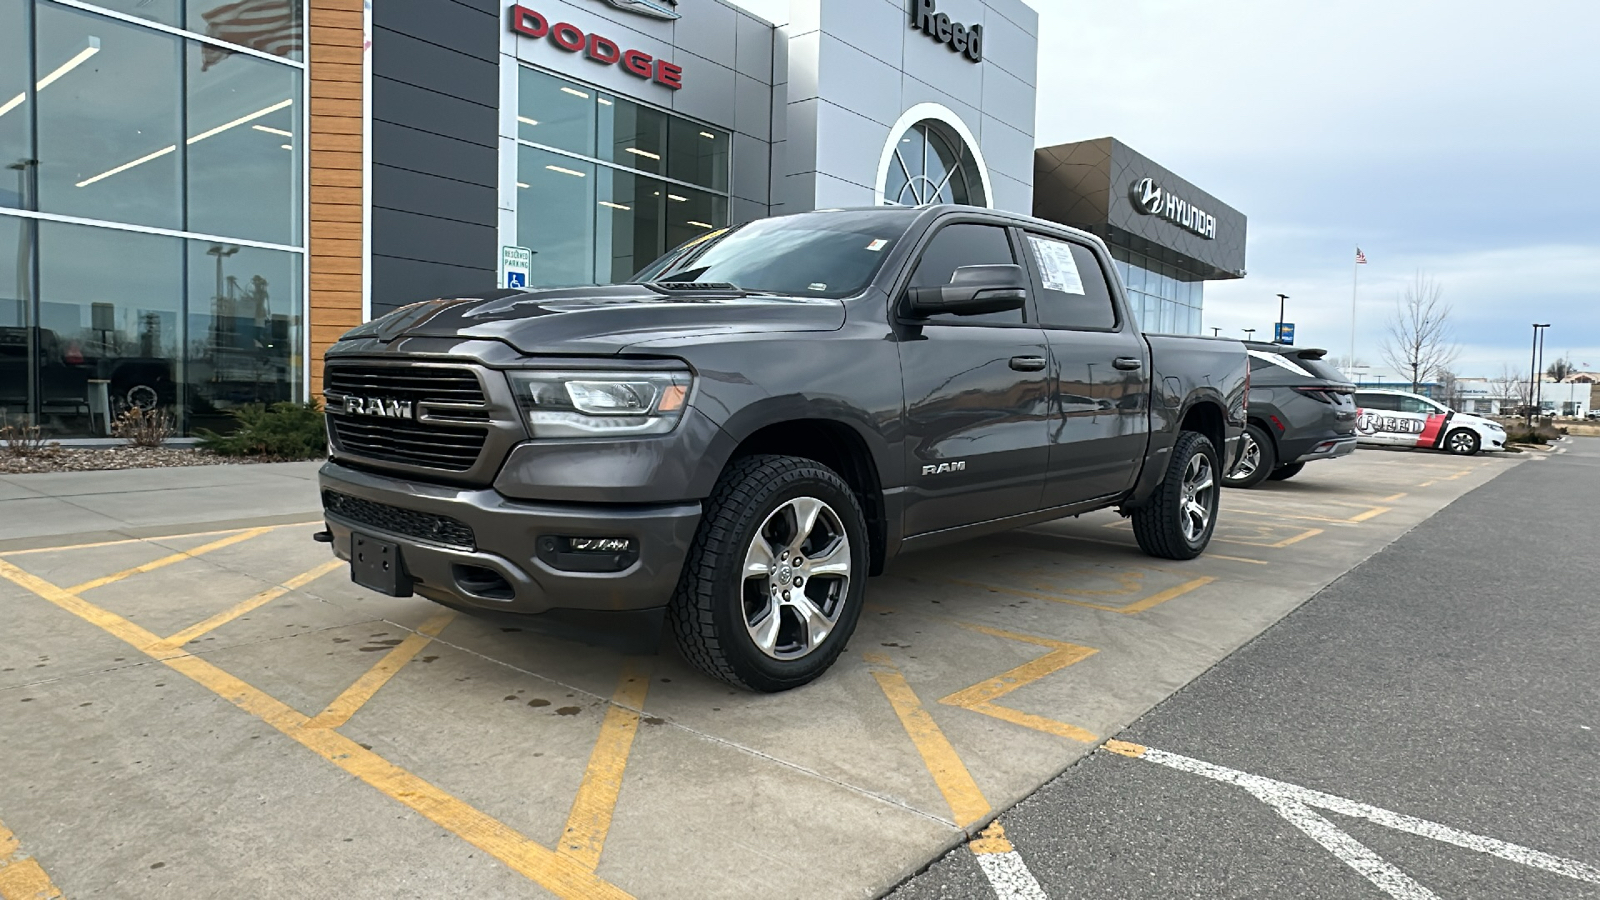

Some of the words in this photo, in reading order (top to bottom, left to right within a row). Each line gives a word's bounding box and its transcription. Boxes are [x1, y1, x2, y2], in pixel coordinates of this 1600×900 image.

[911, 0, 984, 63] Reed
[510, 3, 683, 90] DODGE
[1165, 192, 1216, 239] HYUNDAI
[505, 250, 528, 260] RESERVED
[505, 259, 528, 268] PARKING
[343, 395, 413, 419] RAM
[1357, 413, 1426, 435] REED
[921, 460, 966, 476] RAM
